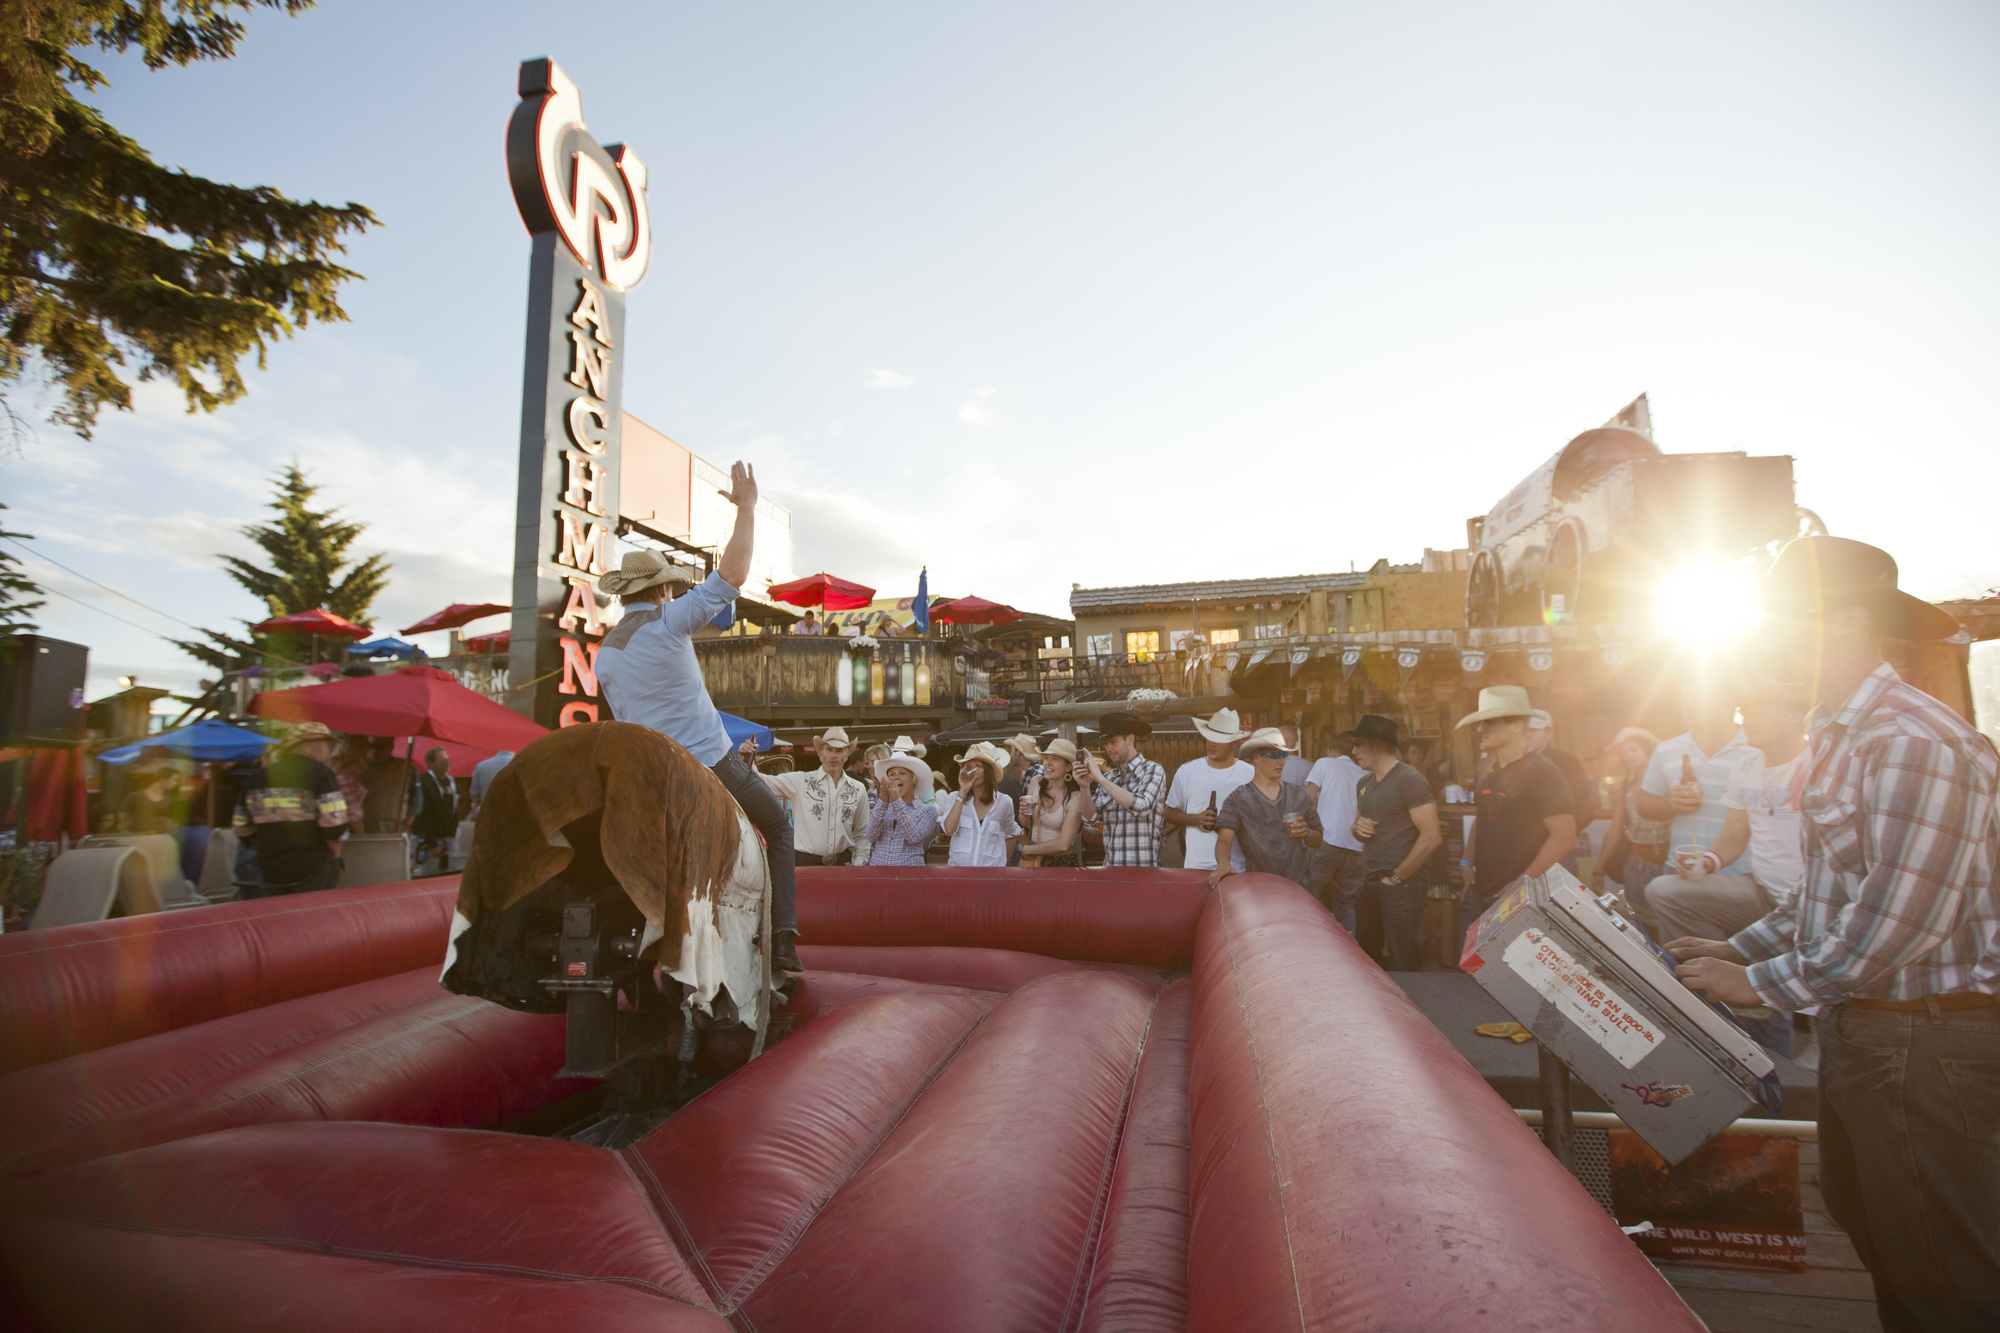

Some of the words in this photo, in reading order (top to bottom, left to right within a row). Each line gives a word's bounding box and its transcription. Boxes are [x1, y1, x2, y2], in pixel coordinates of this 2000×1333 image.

[1535, 952, 1601, 1009] SLOBBERING
[1601, 1008, 1629, 1034] BULL
[1541, 944, 1572, 971] OTHER
[1593, 989, 1606, 1000] IS
[1603, 999, 1622, 1013] AN
[1669, 1227, 1712, 1241] WILD
[1715, 1231, 1763, 1246] WEST
[1766, 1234, 1784, 1247] IS
[1671, 1246, 1695, 1255] WHY
[1698, 1247, 1722, 1257] NOT
[1724, 1249, 1756, 1260] GRAB
